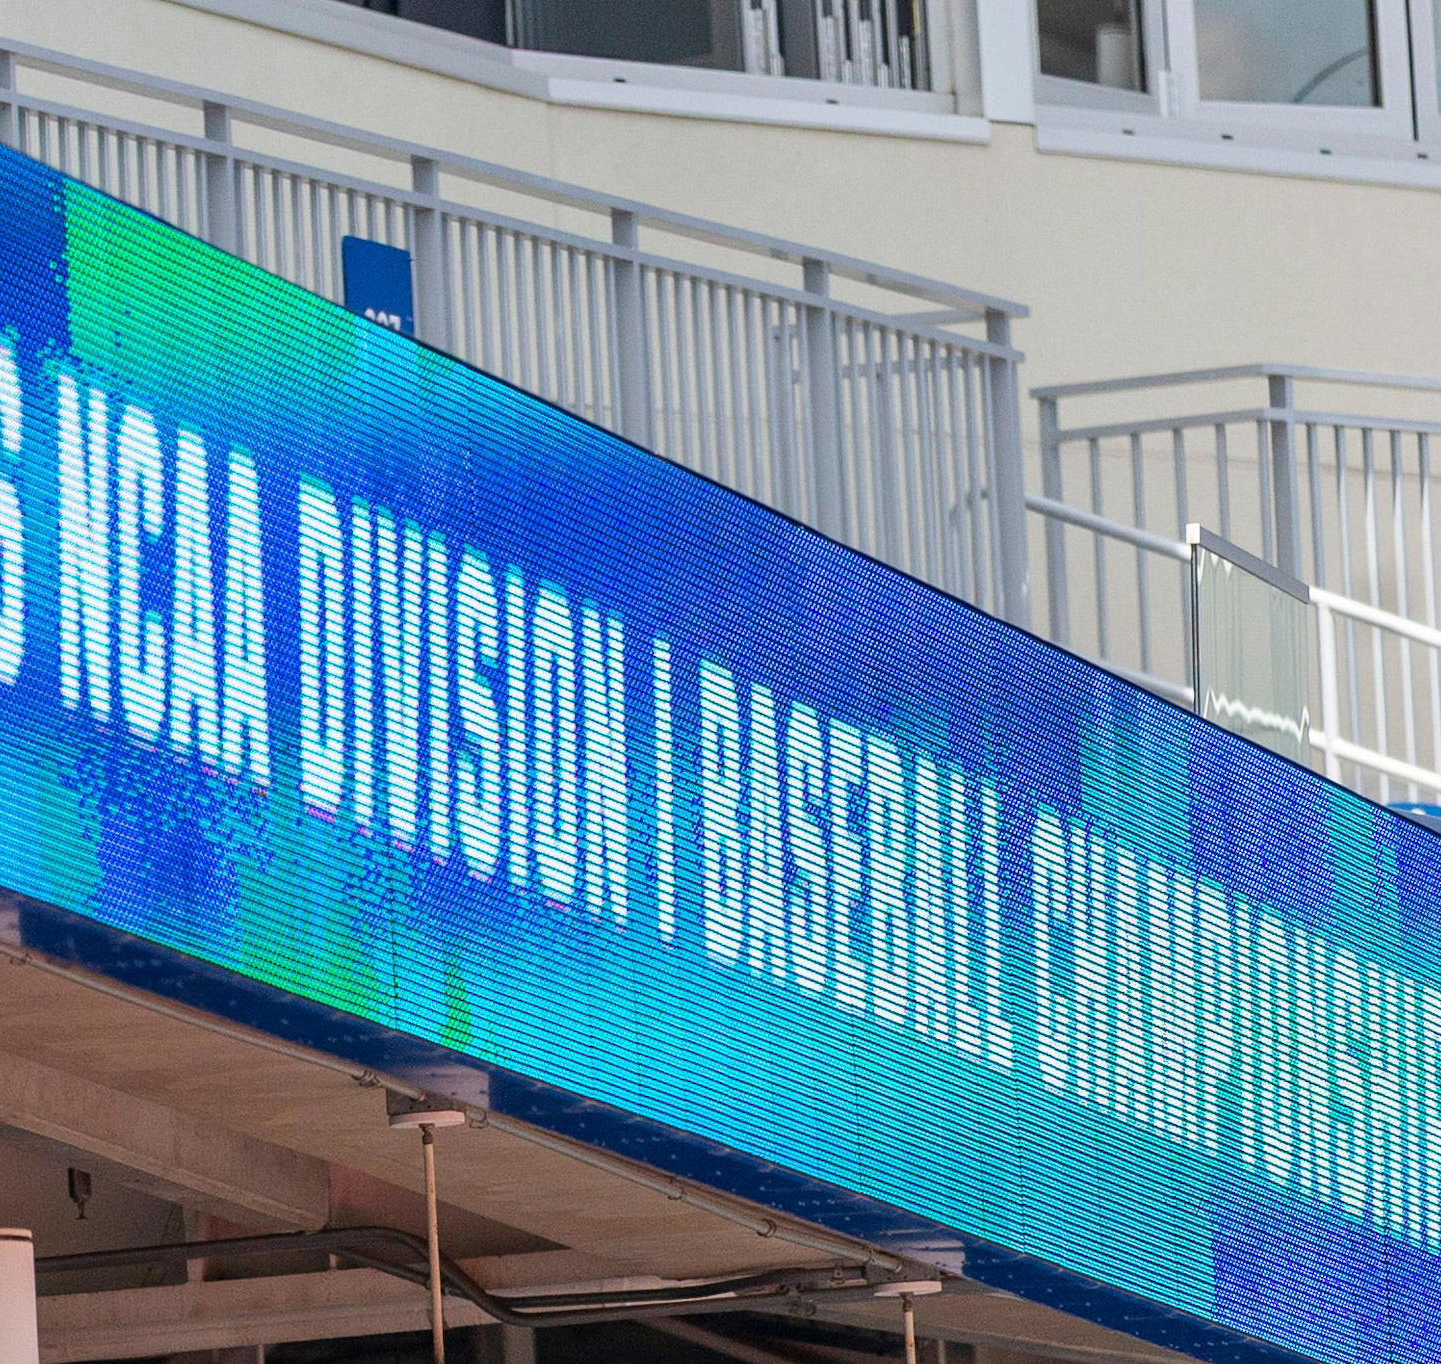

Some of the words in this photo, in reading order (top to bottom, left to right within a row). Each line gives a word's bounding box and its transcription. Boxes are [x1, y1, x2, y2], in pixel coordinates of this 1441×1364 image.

[54, 368, 273, 792] NCAA
[298, 471, 629, 930] DIVISION
[653, 633, 675, 945] I
[700, 656, 1015, 1069] BASEBALL
